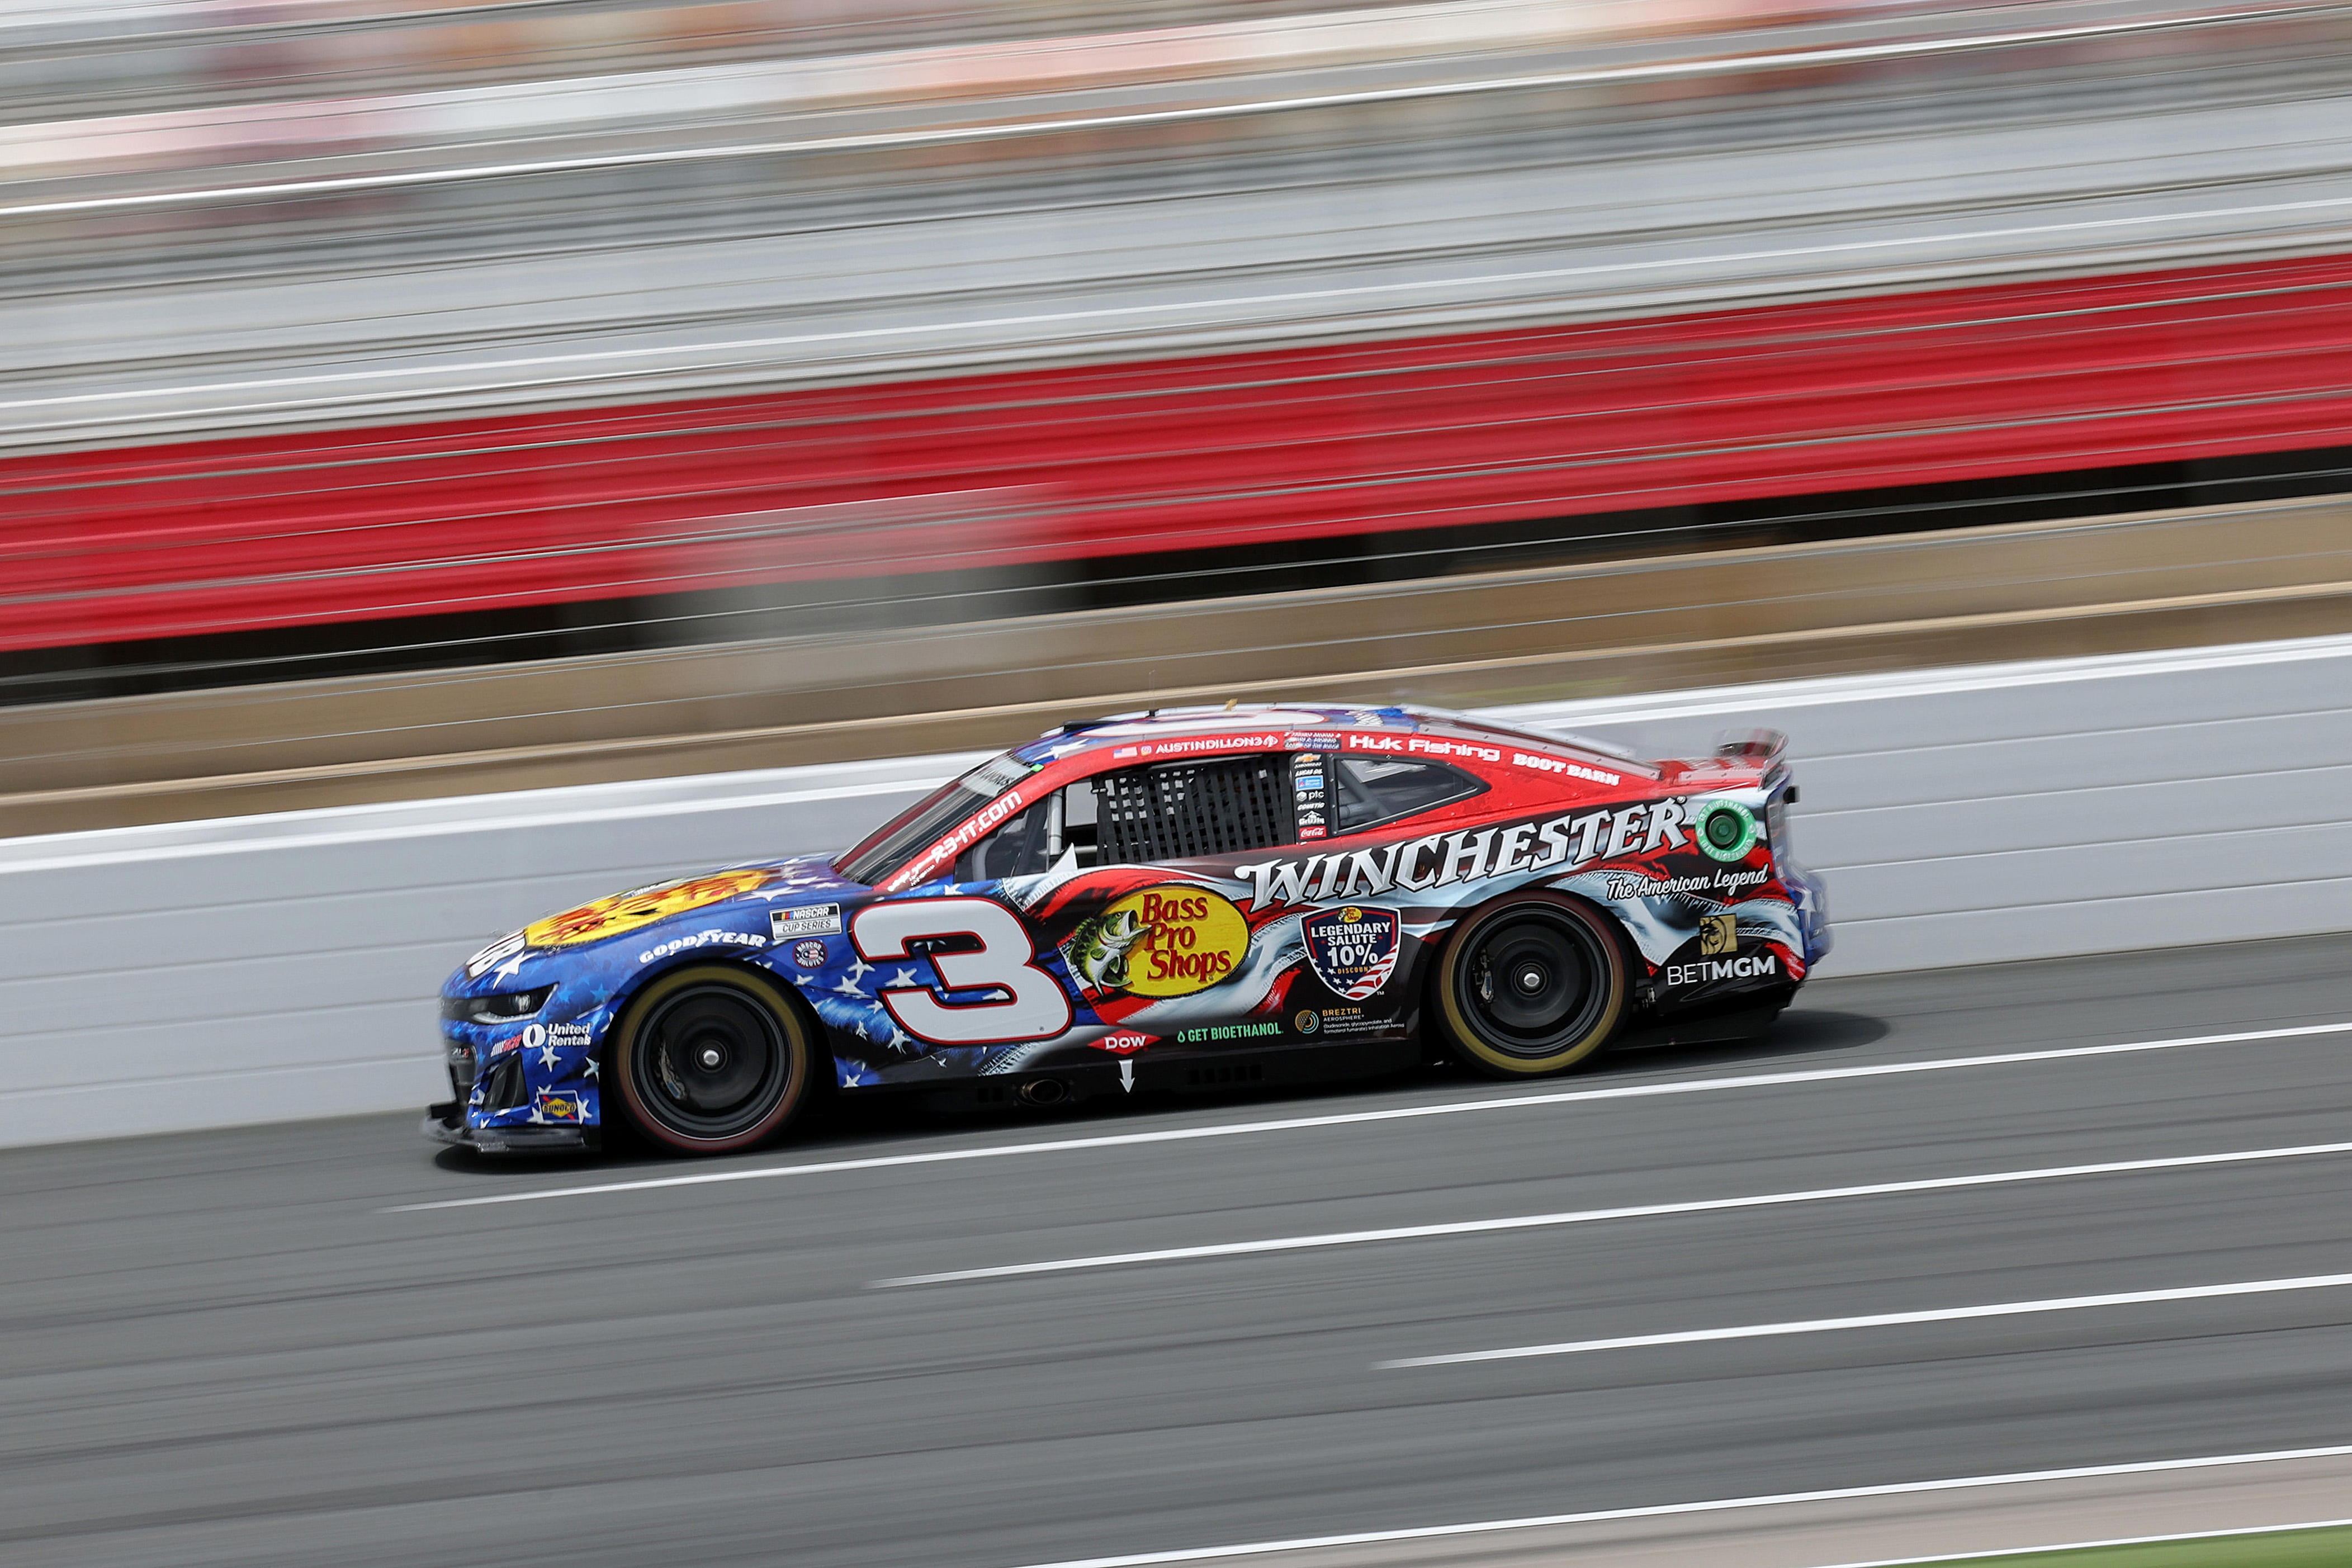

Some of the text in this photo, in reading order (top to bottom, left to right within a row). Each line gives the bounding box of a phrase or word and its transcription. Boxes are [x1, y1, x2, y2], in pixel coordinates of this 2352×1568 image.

[1350, 735, 1500, 761] Huk Fishing
[1512, 753, 1620, 786] BOOT BARN
[1308, 790, 1324, 800] ptc
[1234, 797, 1688, 912] WINCHESTER
[1607, 863, 1768, 899] The American Legend
[793, 907, 829, 920] NASCAR
[783, 919, 831, 932] CUP SERIES
[1311, 922, 1390, 938] LEGENDARY
[639, 929, 766, 964] GOODYEAR
[1140, 893, 1232, 984] Bass Pro Shops
[1328, 934, 1377, 946] SALUTE
[1327, 944, 1379, 967] 10%
[850, 896, 1072, 1046] 3
[1667, 955, 1776, 986] BETMGM
[1322, 1007, 1361, 1016] BREZTRI
[548, 1023, 590, 1035] United
[1188, 1028, 1207, 1042] GET
[548, 1035, 591, 1046] Rentals
[1104, 1036, 1147, 1050] DOW
